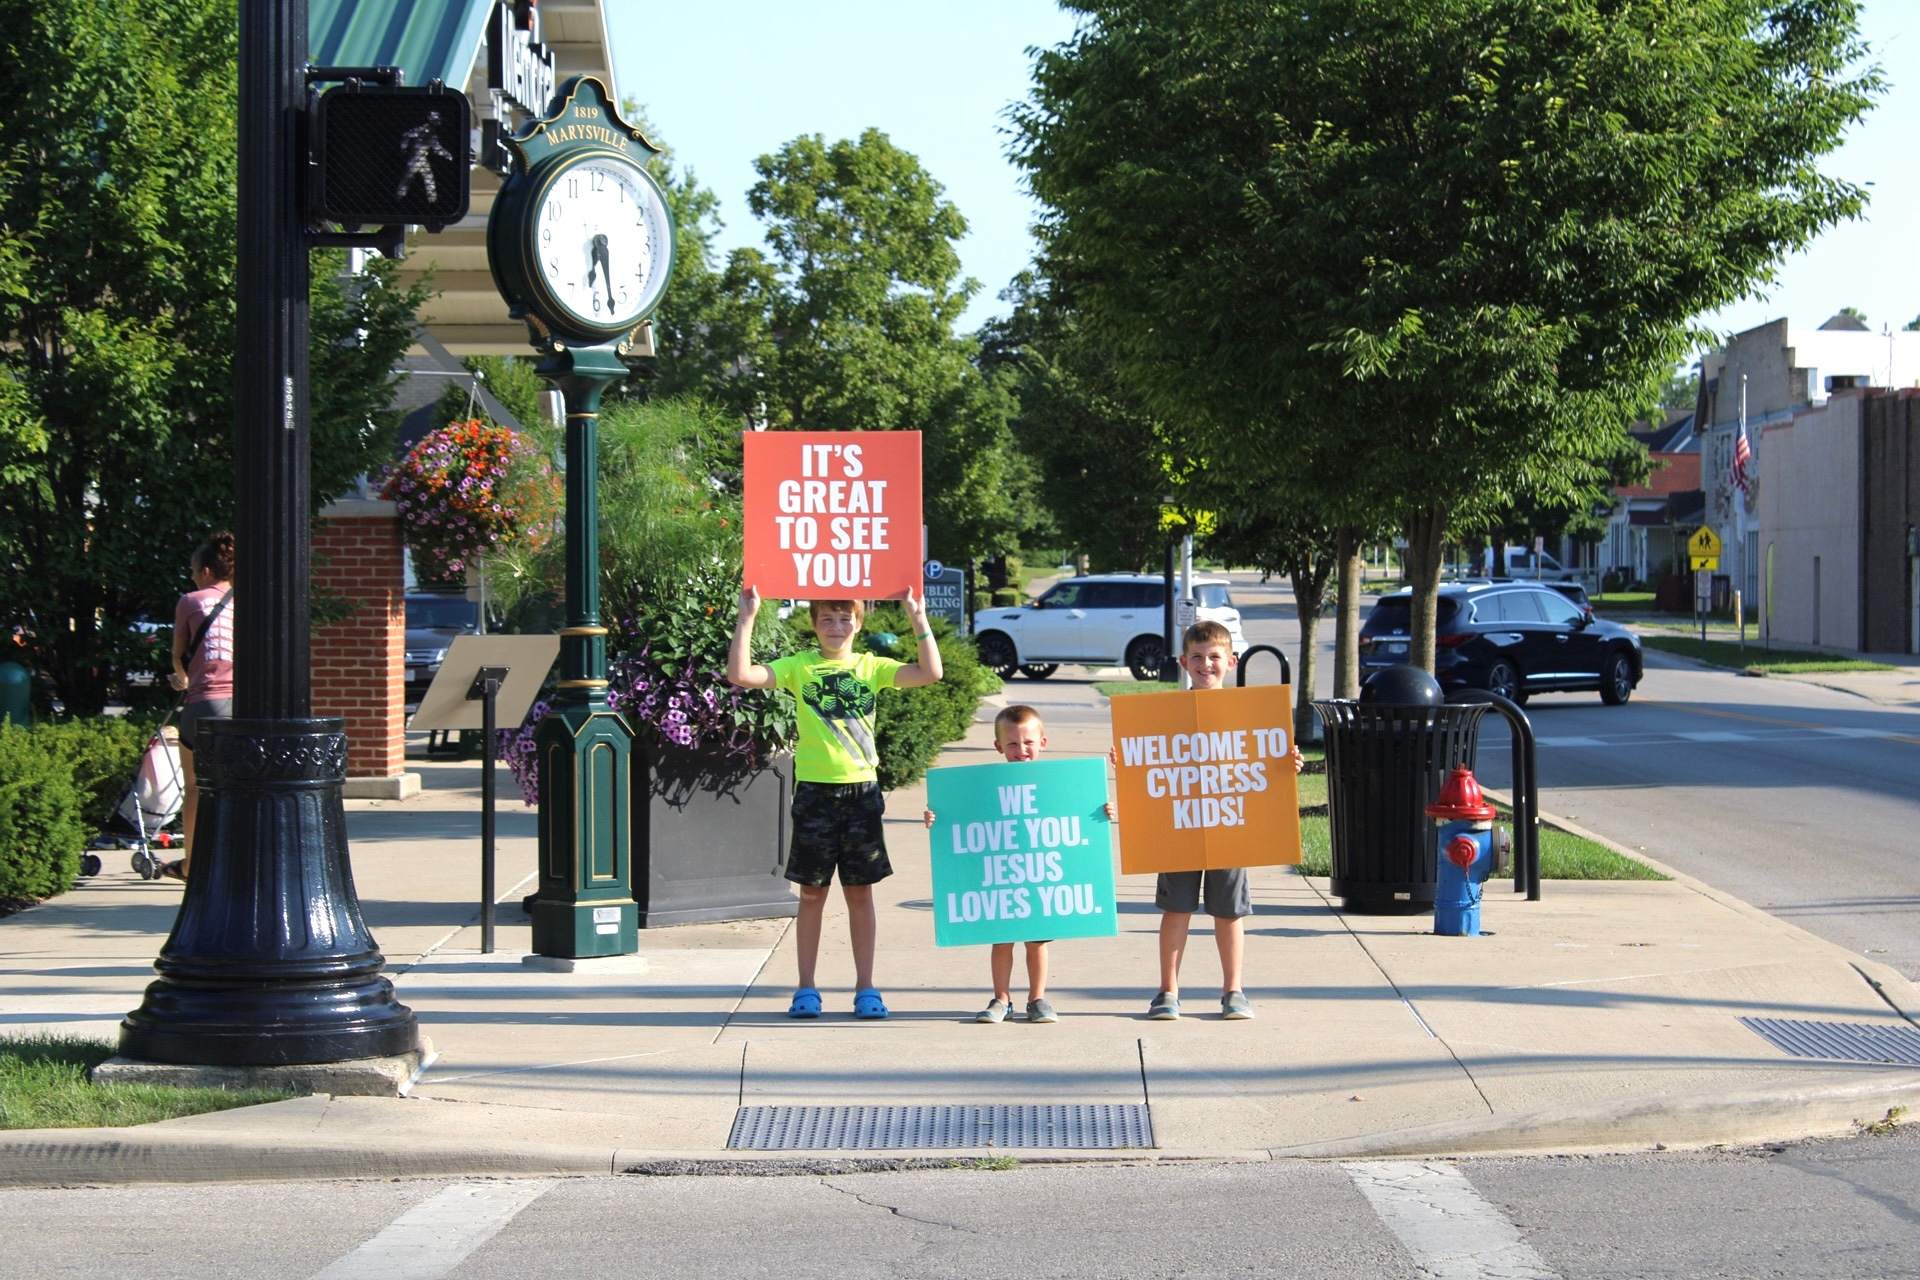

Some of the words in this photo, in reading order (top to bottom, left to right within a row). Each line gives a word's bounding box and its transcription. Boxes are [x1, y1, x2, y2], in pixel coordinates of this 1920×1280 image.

[574, 106, 598, 119] 1819
[546, 124, 628, 151] MARYSVILLE
[568, 178, 578, 199] 11
[590, 171, 604, 192] 12
[619, 183, 624, 203] 1
[548, 200, 562, 222] 10
[636, 206, 644, 226] 2
[542, 229, 551, 249] 9
[549, 257, 559, 279] 8
[635, 263, 644, 283] 4
[592, 291, 601, 312] 6
[618, 285, 627, 305] 5
[802, 444, 863, 478] IT'S
[778, 480, 887, 513] GREAT
[775, 516, 818, 550] TO
[830, 516, 889, 550] SEE
[792, 553, 872, 587] YOU!
[930, 562, 940, 577] P
[924, 586, 956, 597] BLIC
[925, 598, 960, 608] RKING
[1121, 730, 1248, 766] WELCOME
[1252, 728, 1288, 759] TO
[1146, 761, 1268, 798] CYPRESS
[998, 784, 1038, 816] WE
[1172, 796, 1245, 830] KIDS!
[952, 820, 1019, 854] LOVE
[1023, 816, 1089, 849] YOU.
[982, 851, 1063, 887] JESUS
[948, 887, 1032, 923] LOVES
[1037, 884, 1102, 917] YOU.
